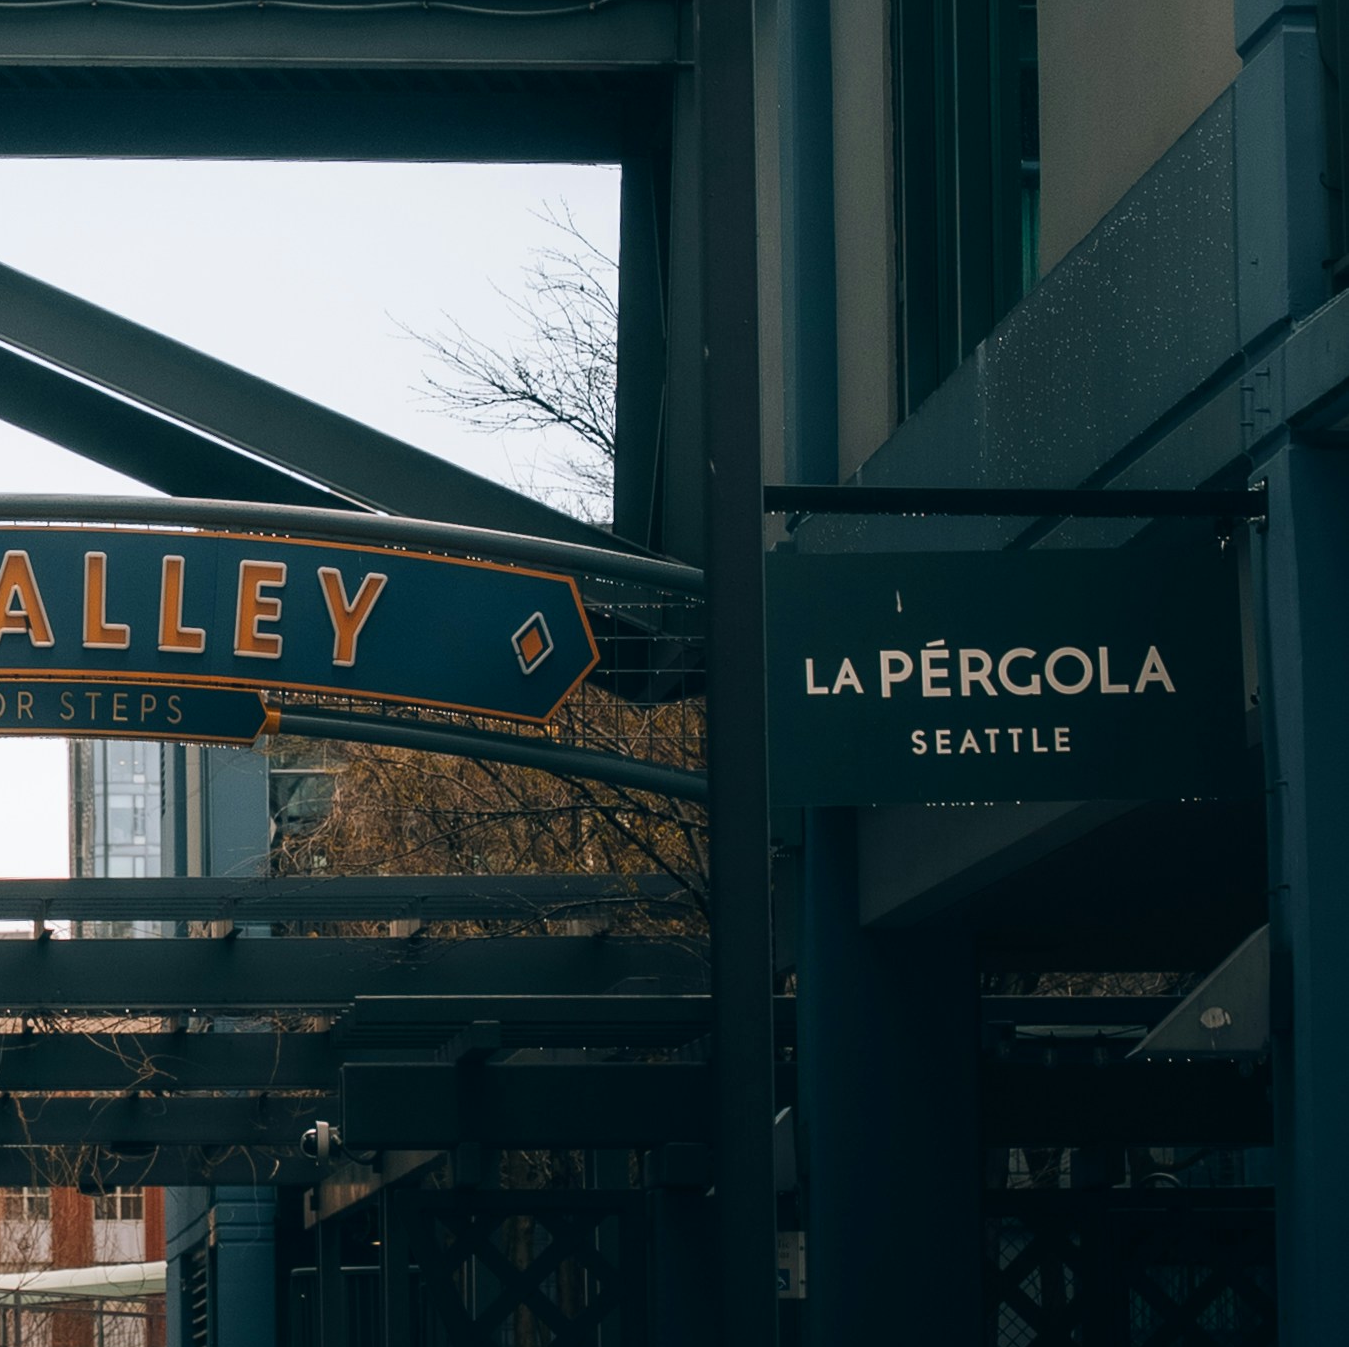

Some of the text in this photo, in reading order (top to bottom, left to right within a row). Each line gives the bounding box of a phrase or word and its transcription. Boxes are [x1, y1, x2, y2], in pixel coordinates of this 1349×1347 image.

[805, 638, 1176, 698] LA PÉRGOLA
[60, 691, 183, 724] STEPS
[911, 727, 1071, 755] SEATTLE
